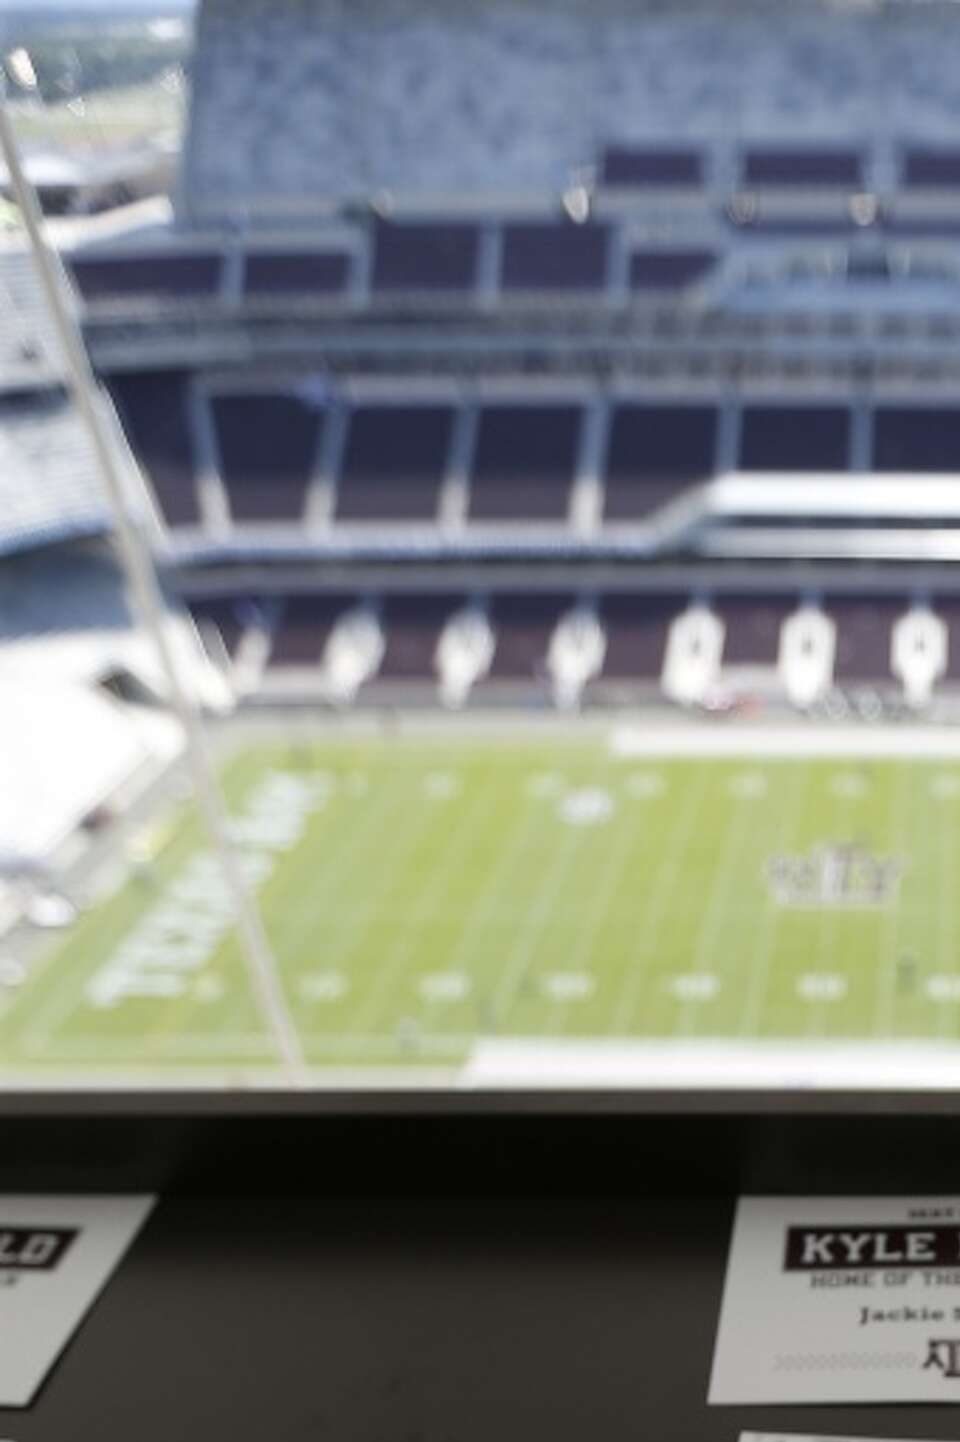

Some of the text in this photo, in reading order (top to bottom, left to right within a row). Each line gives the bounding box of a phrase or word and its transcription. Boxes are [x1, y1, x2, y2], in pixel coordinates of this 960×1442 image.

[802, 1233, 936, 1263] KYLE
[810, 1271, 873, 1287] HOME
[883, 1271, 911, 1287] OF
[859, 1306, 944, 1327] Jackie
